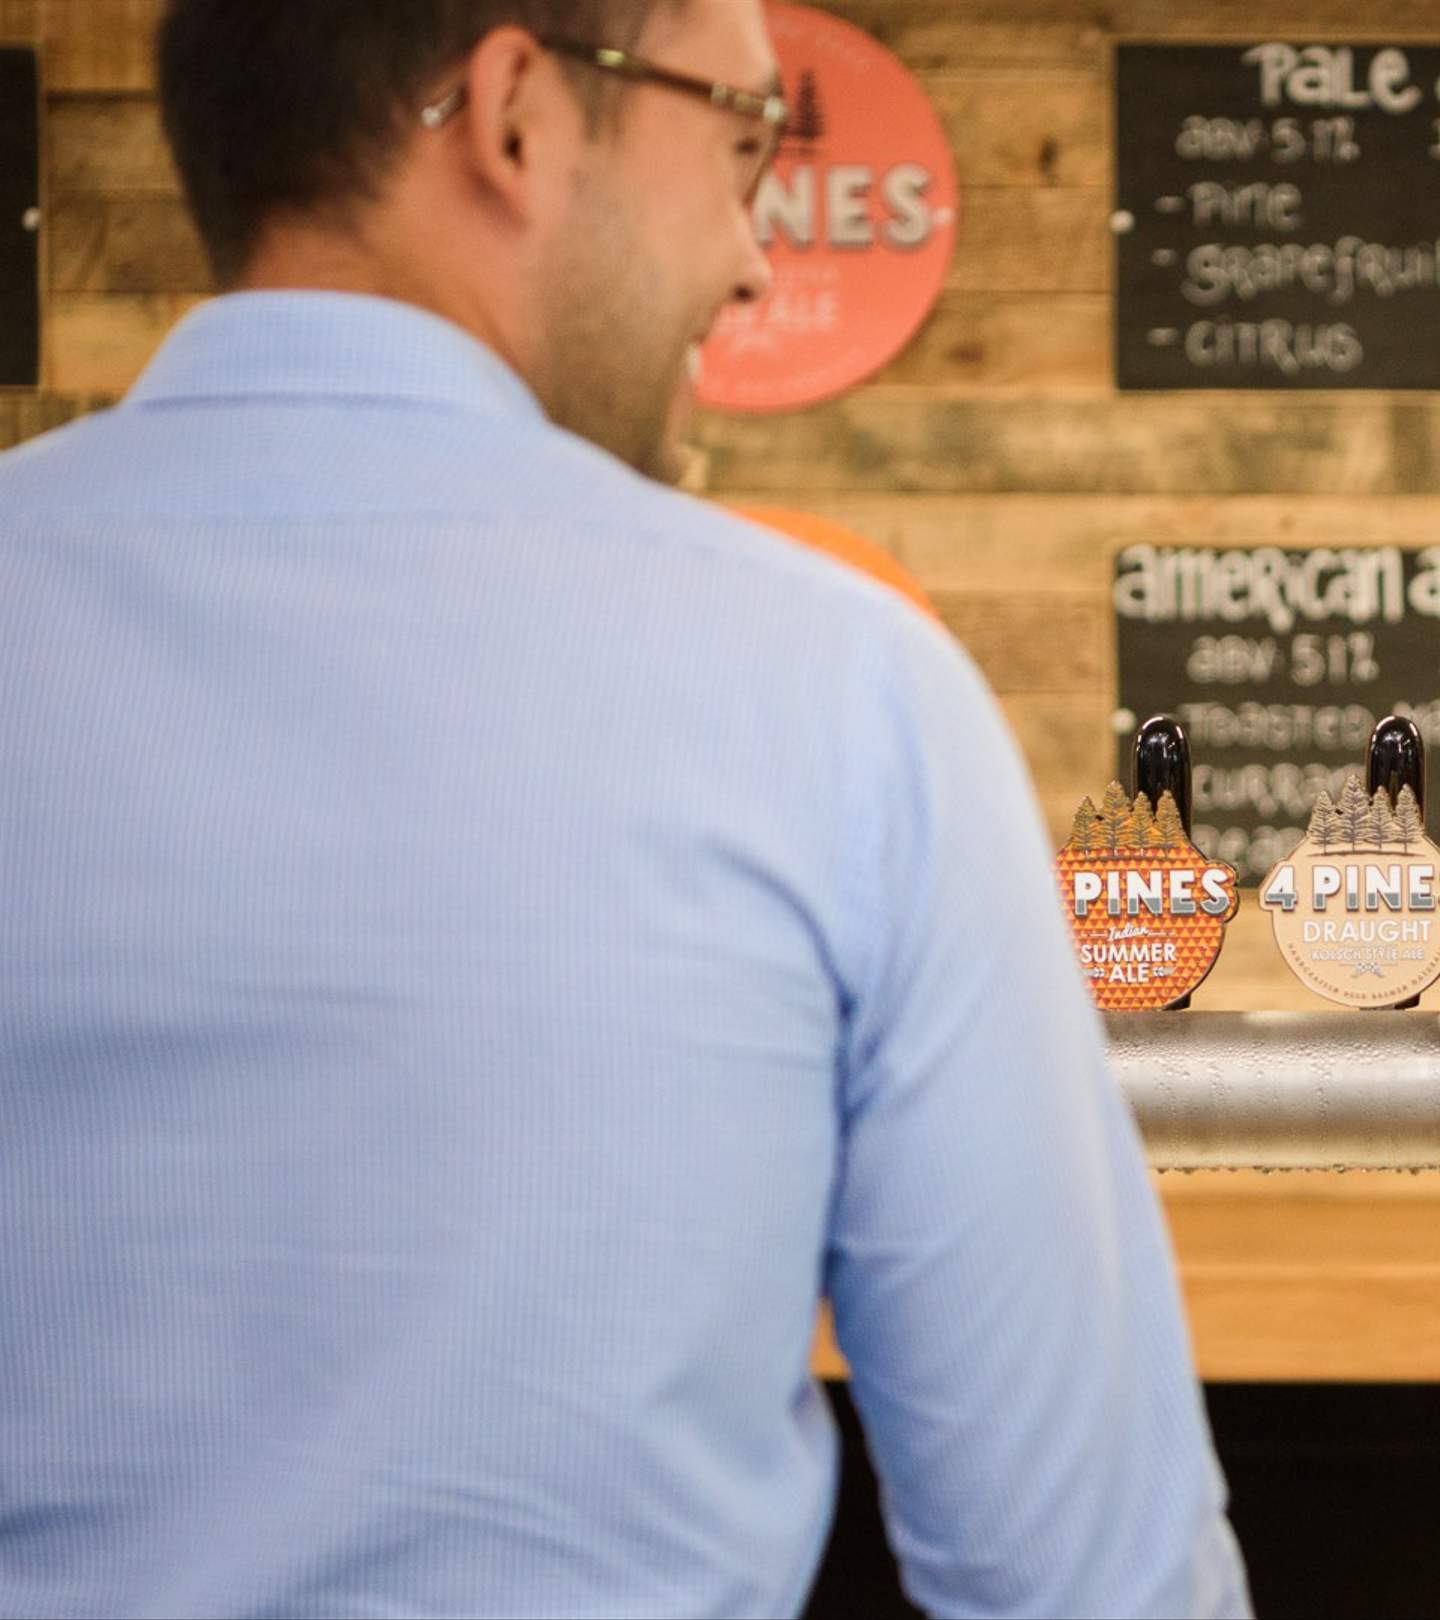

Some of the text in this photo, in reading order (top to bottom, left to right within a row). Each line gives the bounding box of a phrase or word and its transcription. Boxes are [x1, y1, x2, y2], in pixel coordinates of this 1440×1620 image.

[752, 162, 933, 250] NES
[1073, 868, 1231, 916] PINES
[1265, 865, 1298, 912] 4
[1107, 923, 1149, 941] Indian
[1303, 920, 1432, 943] DRAUGHT
[1080, 943, 1176, 963] SUMMER
[1108, 964, 1149, 983] ALE
